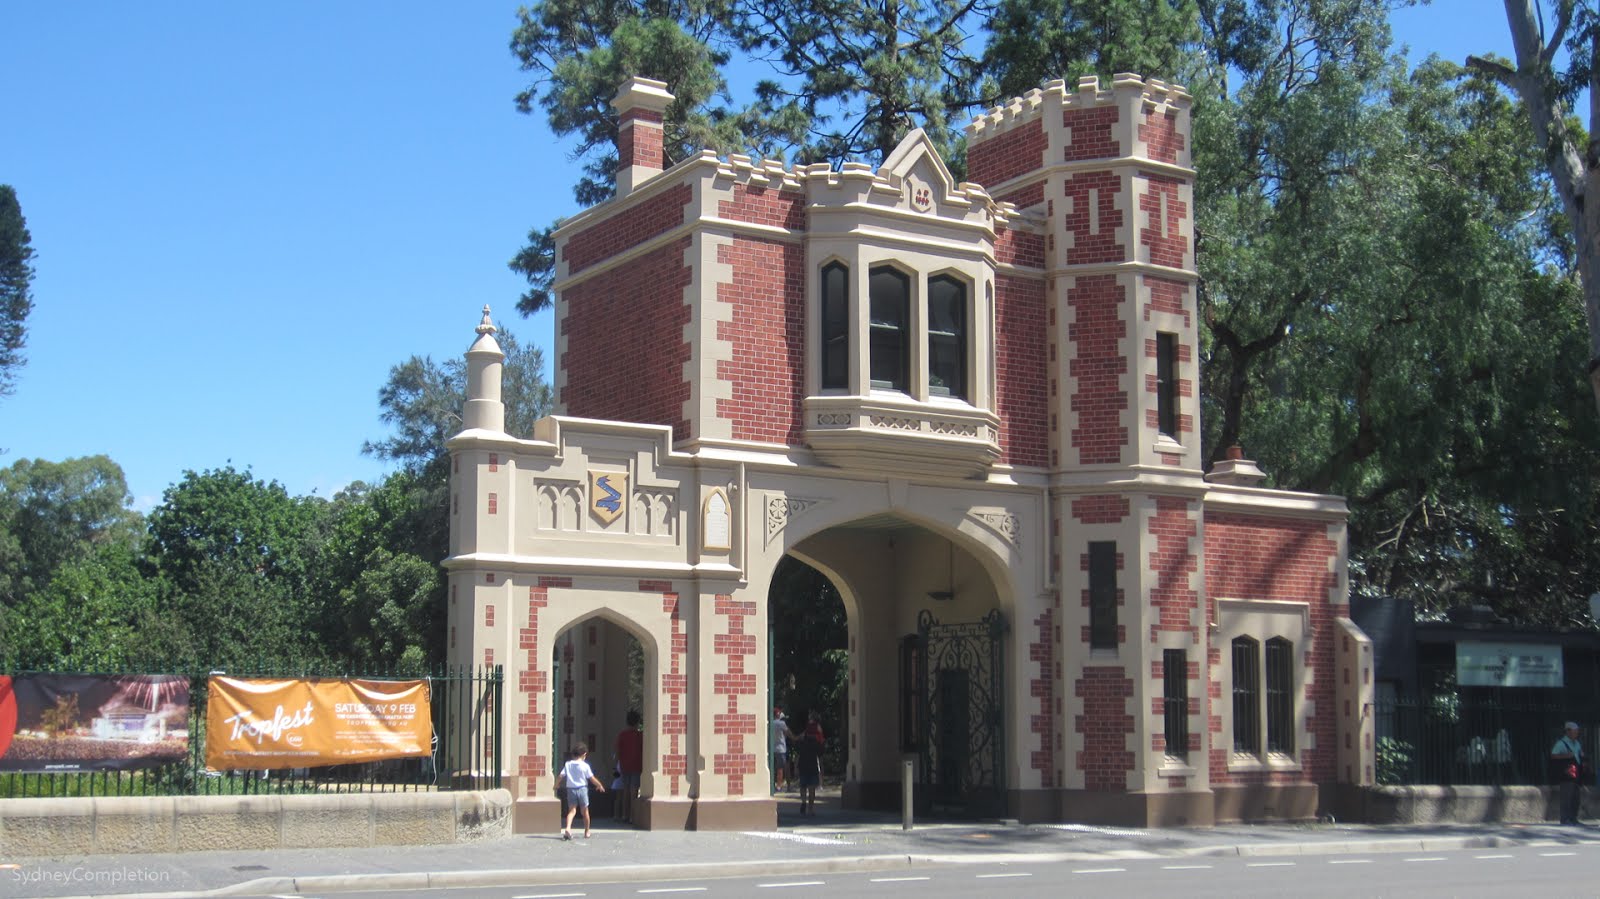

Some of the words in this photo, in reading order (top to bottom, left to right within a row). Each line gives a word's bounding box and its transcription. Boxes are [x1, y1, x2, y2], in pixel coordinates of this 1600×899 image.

[335, 703, 387, 713] SATURDAY
[390, 704, 397, 713] 9
[399, 703, 416, 713] FEB
[224, 700, 314, 744] Tropfest
